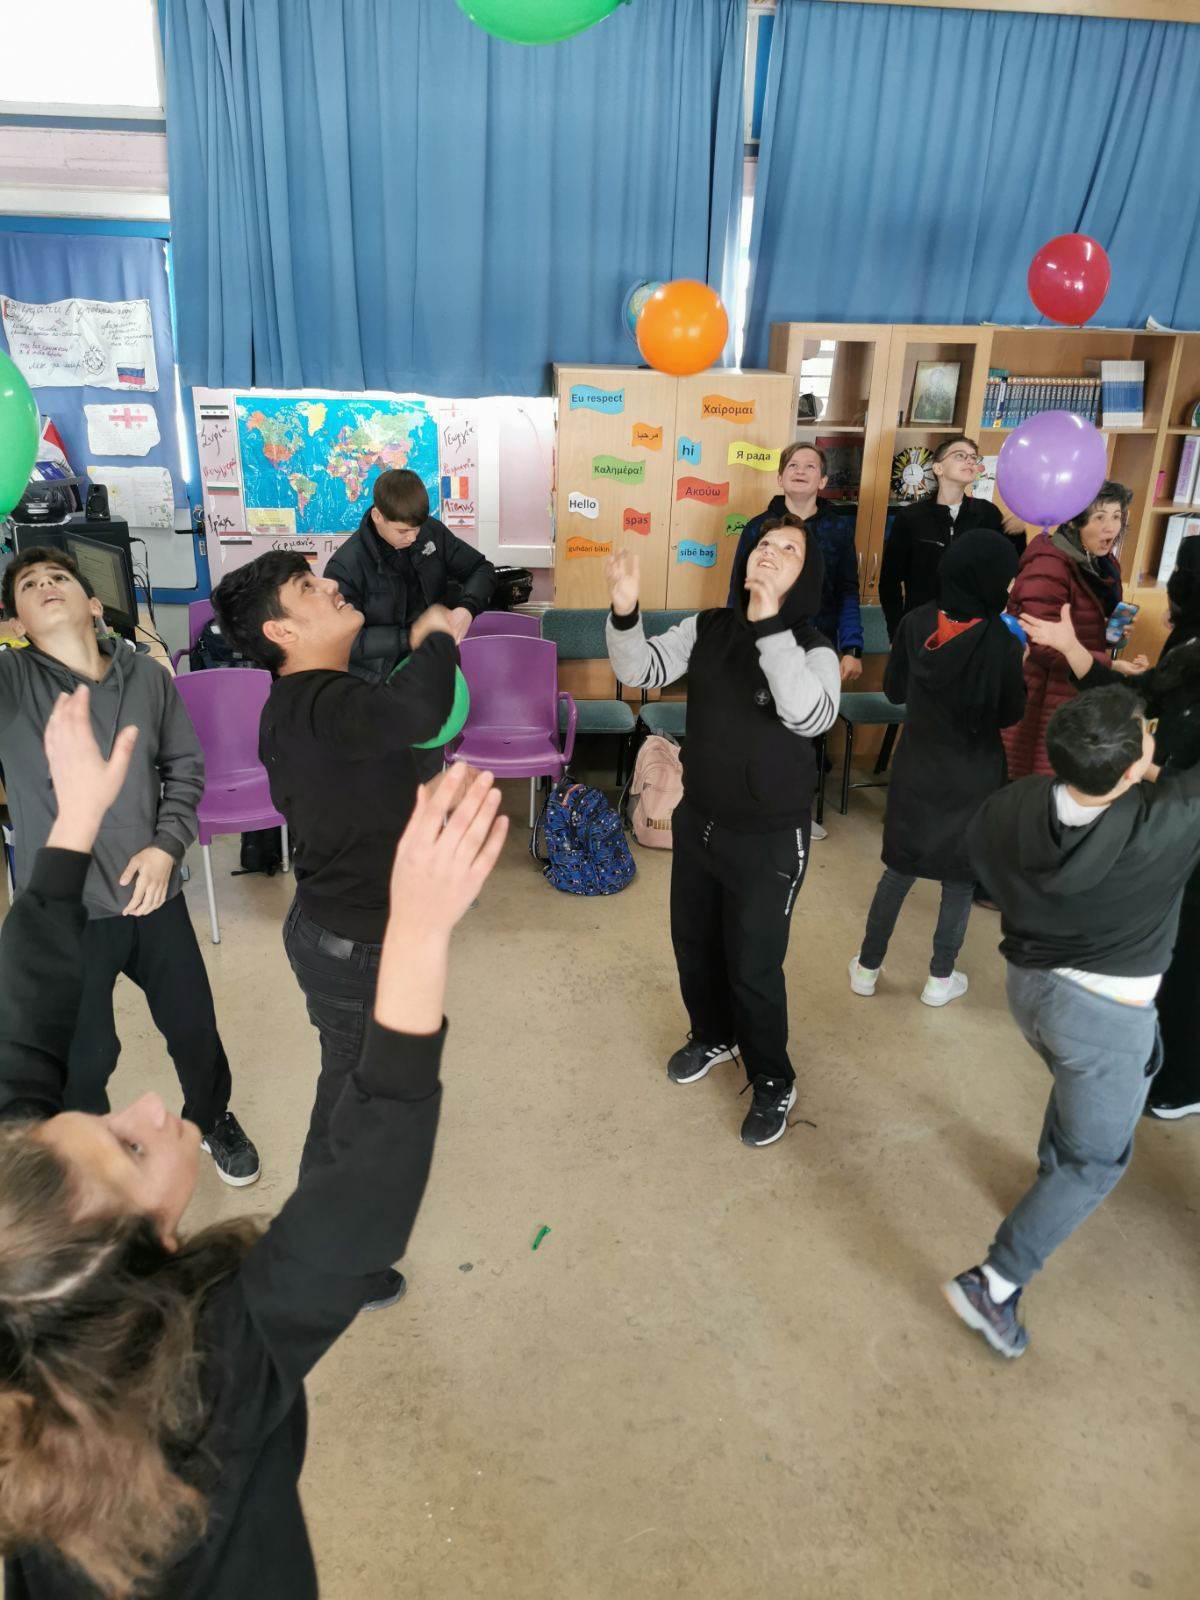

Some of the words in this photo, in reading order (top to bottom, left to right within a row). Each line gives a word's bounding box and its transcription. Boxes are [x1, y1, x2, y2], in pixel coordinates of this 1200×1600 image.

[571, 394, 584, 403] Eu
[587, 393, 623, 404] respect
[703, 404, 753, 416] Χαίρομαι
[682, 445, 695, 456] hi
[736, 451, 744, 459] Я
[746, 452, 771, 461] рада
[594, 465, 643, 475] Καλημέρα!
[685, 486, 721, 497] Ακούω
[569, 499, 597, 509] Hello
[625, 517, 649, 526] spas
